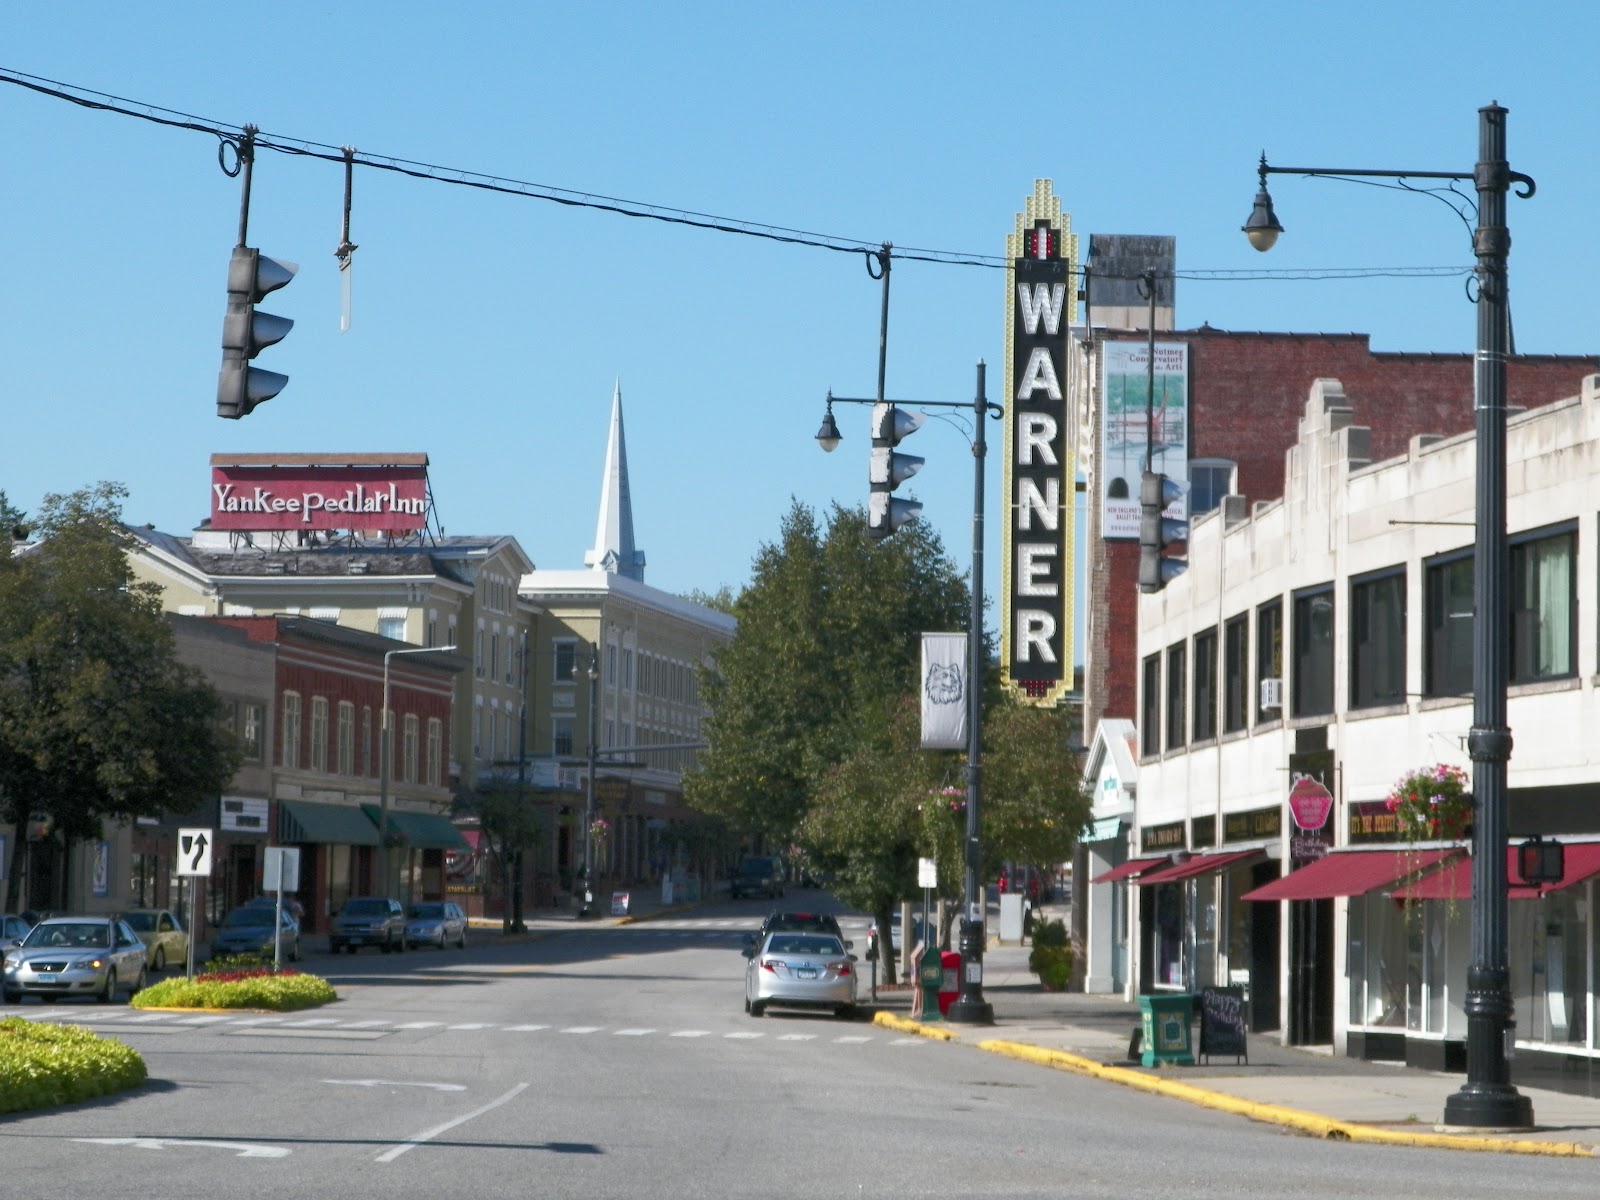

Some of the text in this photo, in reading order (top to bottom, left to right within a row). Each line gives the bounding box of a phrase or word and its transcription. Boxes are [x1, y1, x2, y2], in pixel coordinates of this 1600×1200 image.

[1153, 347, 1184, 358] Nutmeg
[1165, 363, 1183, 371] Arts
[1017, 283, 1067, 663] WARNER
[213, 482, 425, 522] Yankee Pedlar Inn
[1294, 838, 1330, 851] Birthday
[1204, 989, 1241, 1013] Happy
